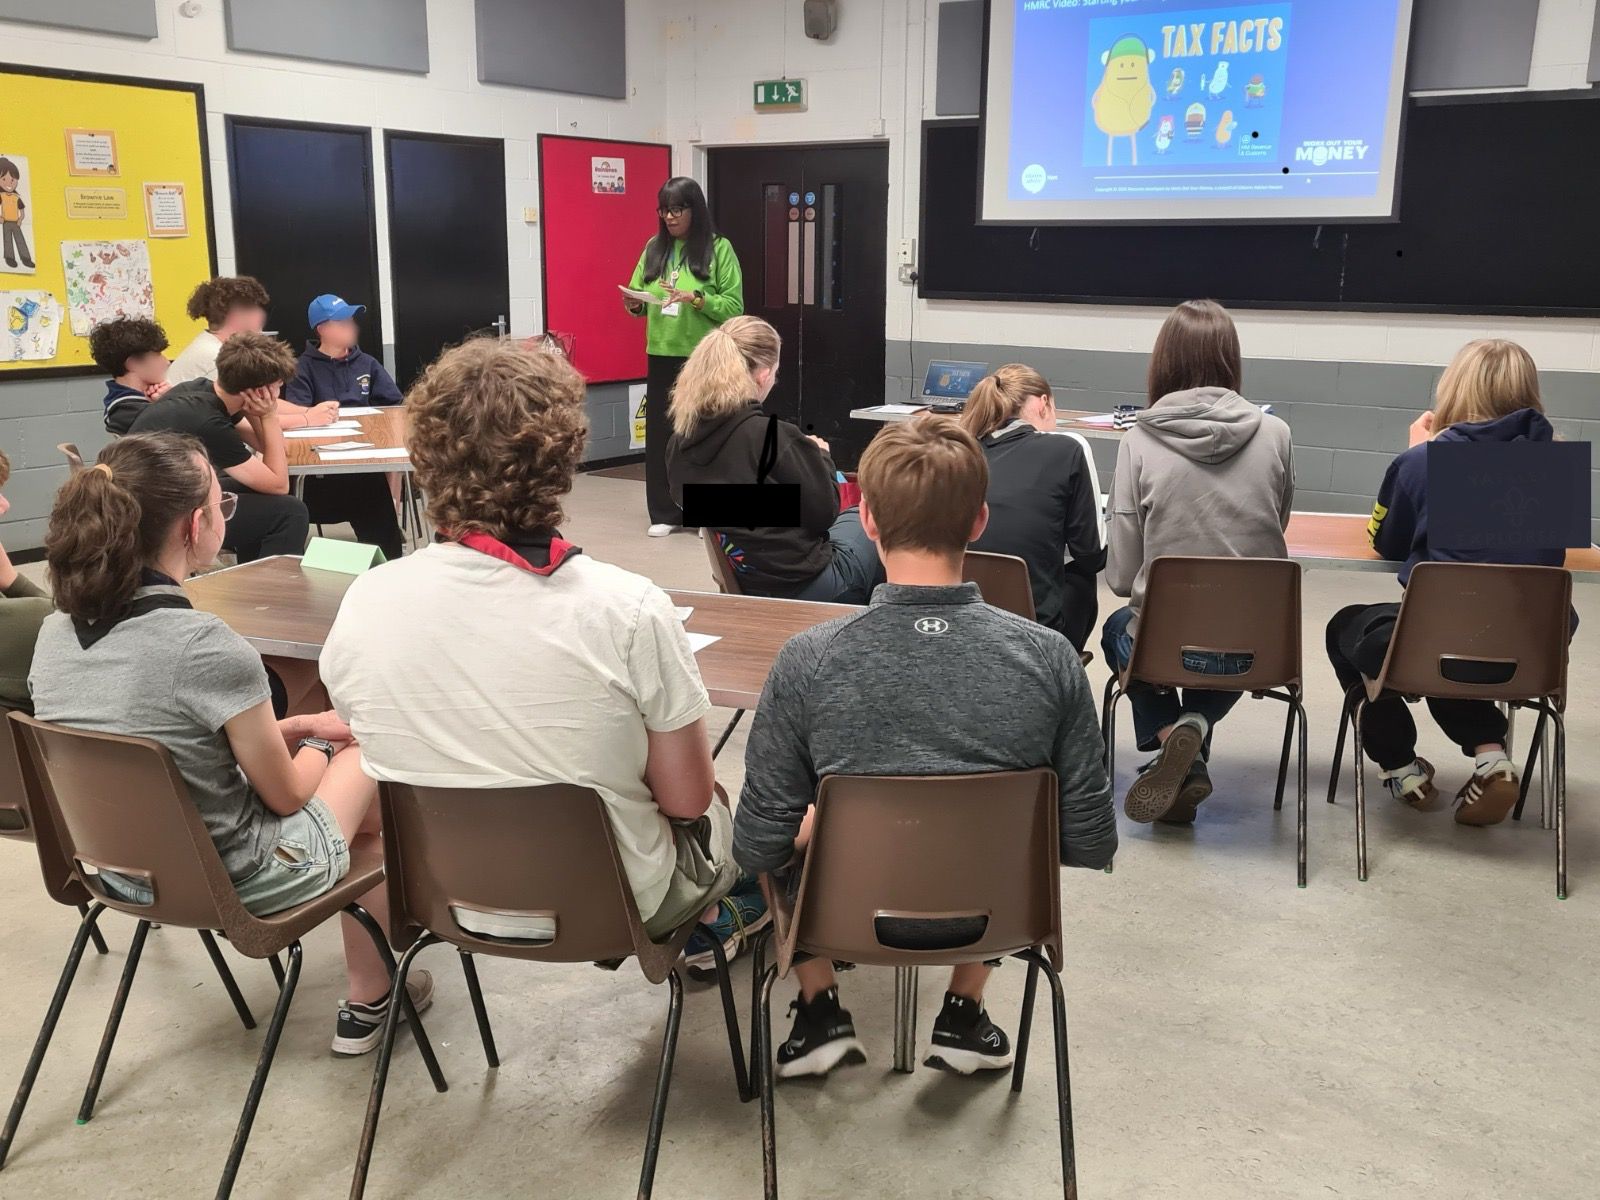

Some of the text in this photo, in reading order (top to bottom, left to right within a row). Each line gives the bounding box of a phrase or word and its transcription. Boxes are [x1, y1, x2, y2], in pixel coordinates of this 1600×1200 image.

[1024, 0, 1051, 11] HMRC
[1052, 0, 1081, 8] Video:
[1162, 17, 1283, 58] TAX FACTS
[1295, 146, 1369, 166] MONEY
